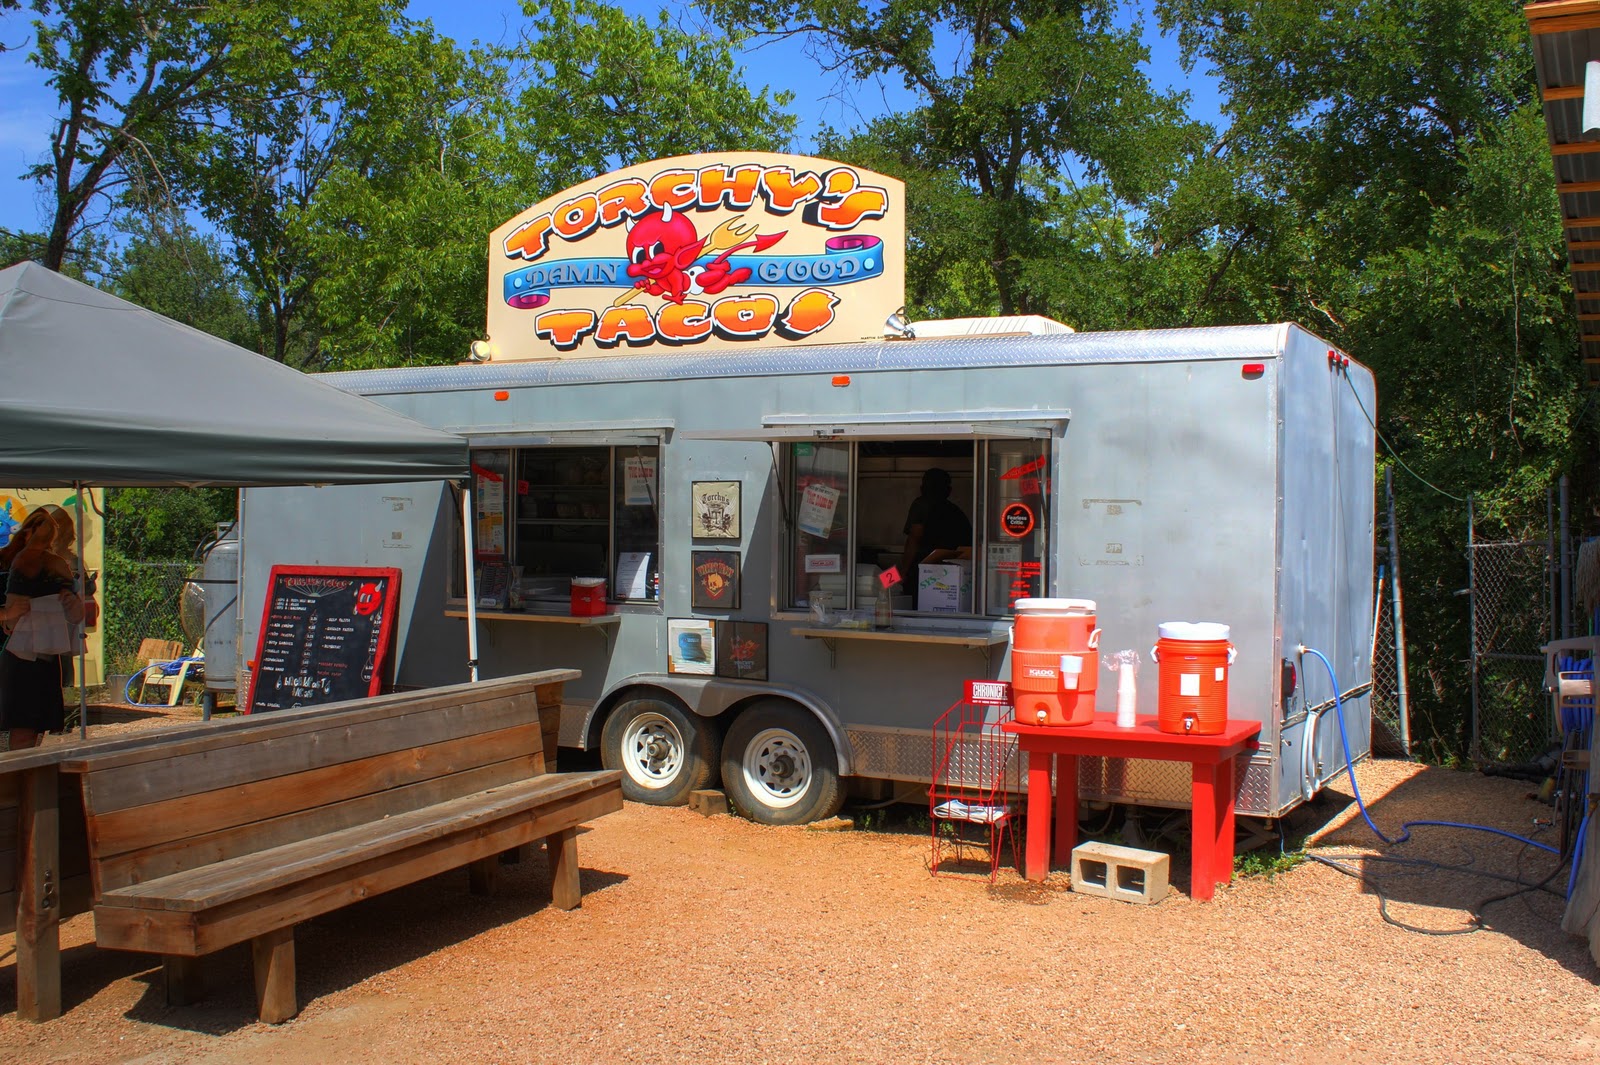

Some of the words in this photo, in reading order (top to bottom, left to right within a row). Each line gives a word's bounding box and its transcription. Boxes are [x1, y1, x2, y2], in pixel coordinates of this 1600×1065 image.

[502, 163, 890, 261] TORCHY'S
[525, 259, 621, 289] DAMN
[757, 255, 861, 284] GOOD
[535, 287, 842, 351] TACOS
[886, 572, 895, 584] 2
[973, 684, 1008, 698] CHRONICLE
